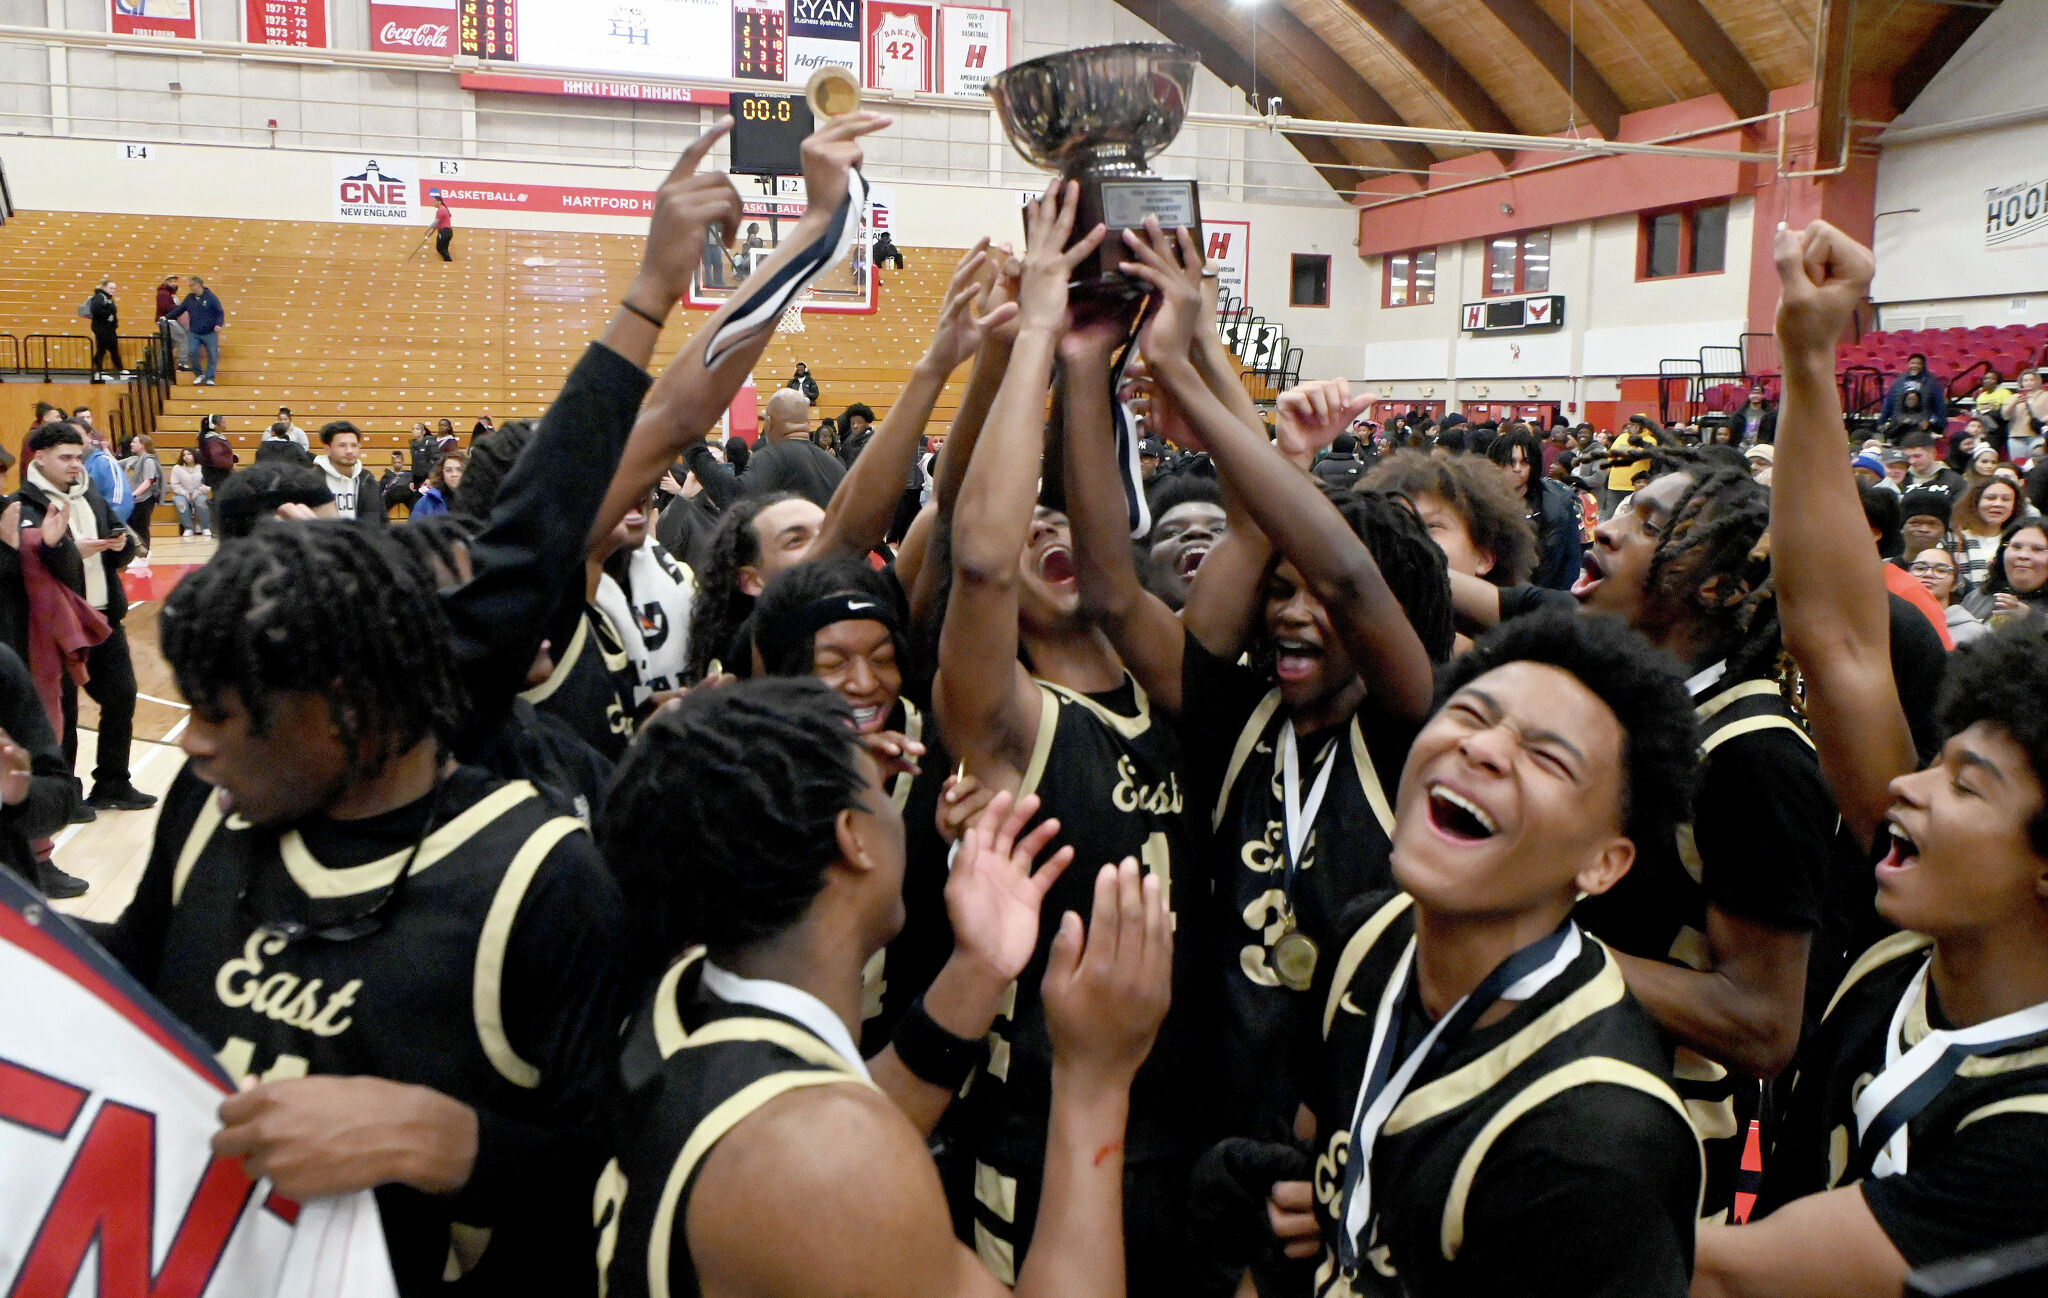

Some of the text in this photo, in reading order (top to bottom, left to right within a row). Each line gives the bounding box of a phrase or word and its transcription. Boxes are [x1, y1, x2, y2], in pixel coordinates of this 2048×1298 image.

[266, 3, 286, 14] 1971
[294, 6, 306, 16] 72
[465, 3, 513, 17] 12 0 0
[793, 0, 855, 22] RYAN
[265, 15, 288, 26] 1972
[295, 18, 308, 28] 73
[462, 15, 513, 30] 21 0 0
[746, 14, 783, 26] 1 2 11
[794, 17, 819, 26] Business
[265, 26, 288, 38] 1973
[295, 29, 308, 40] 74
[380, 21, 450, 49] Coca-Cola
[462, 28, 478, 40] 22
[505, 31, 513, 42] 0
[743, 25, 783, 38] 2 1 4
[884, 28, 917, 41] BAKER
[462, 41, 513, 55] 44 0 0
[744, 37, 783, 51] 3 4 18
[885, 41, 915, 60] 42
[743, 50, 783, 62] 4 3 2
[965, 44, 987, 68] H
[740, 62, 783, 75] 11 4 6
[743, 98, 791, 122] 00.0
[127, 145, 148, 159] E4
[440, 161, 459, 175] E3
[781, 179, 798, 192] E2
[340, 182, 406, 206] CNE
[441, 188, 517, 202] BASKETBALL
[562, 195, 639, 210] HARTFORD
[743, 202, 802, 214] ASKBALL
[341, 208, 407, 218] NEW ENGLAND
[1207, 232, 1232, 260] H
[1467, 306, 1481, 328] H
[1112, 754, 1184, 815] East
[215, 926, 364, 1037] East
